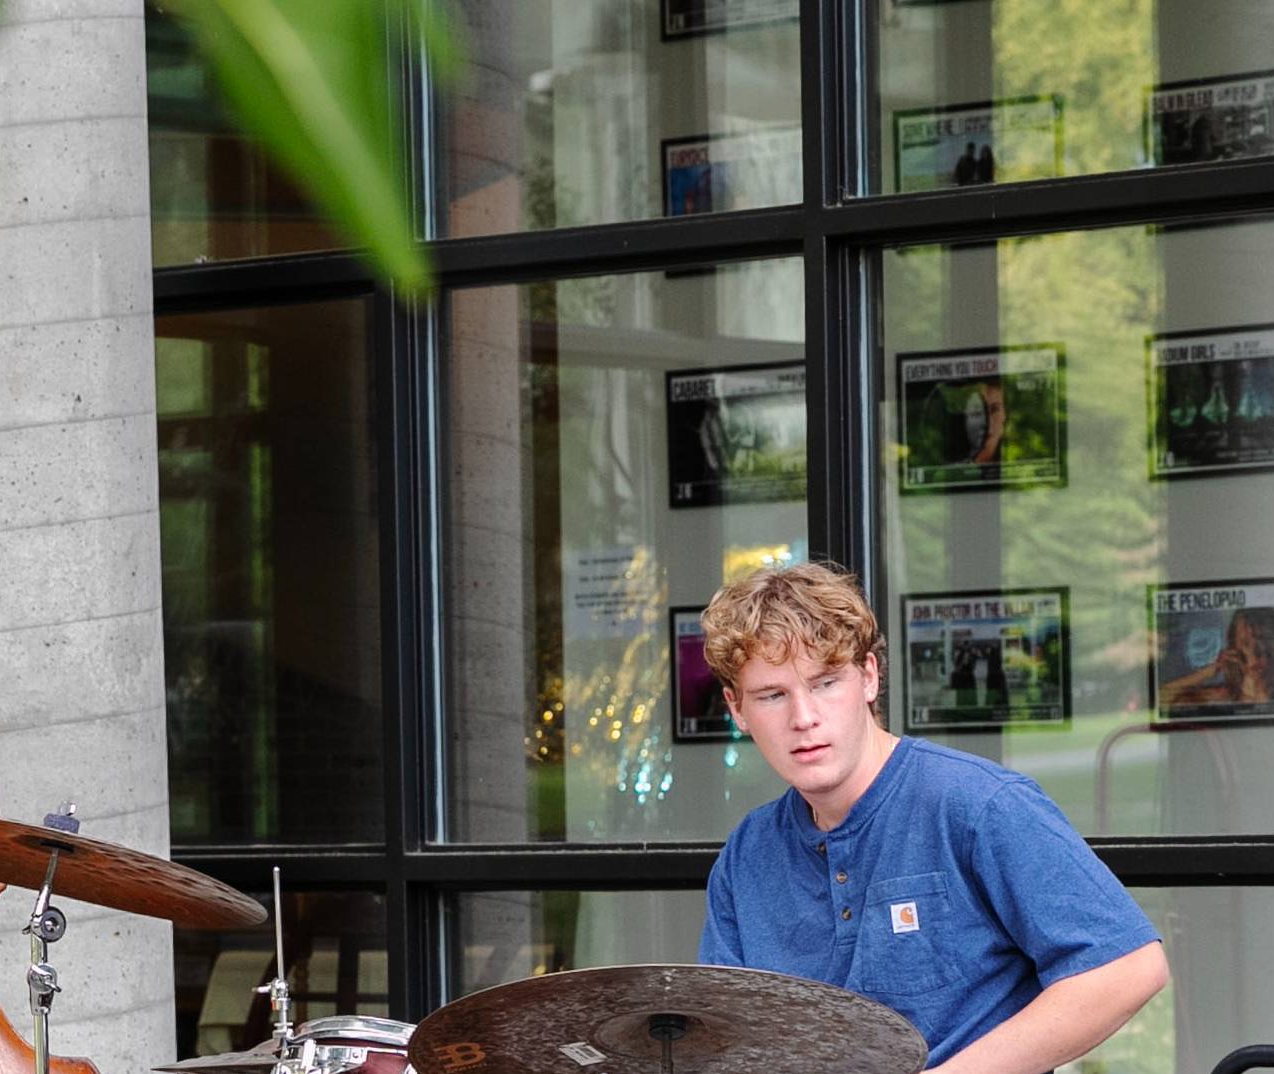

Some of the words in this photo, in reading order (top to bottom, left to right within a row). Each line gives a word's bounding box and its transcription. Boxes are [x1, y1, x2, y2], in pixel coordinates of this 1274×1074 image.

[906, 361, 953, 380] EVERYTHING
[955, 360, 970, 376] YOU
[1158, 592, 1177, 611] THE
[1179, 589, 1246, 609] PENELOPIAD
